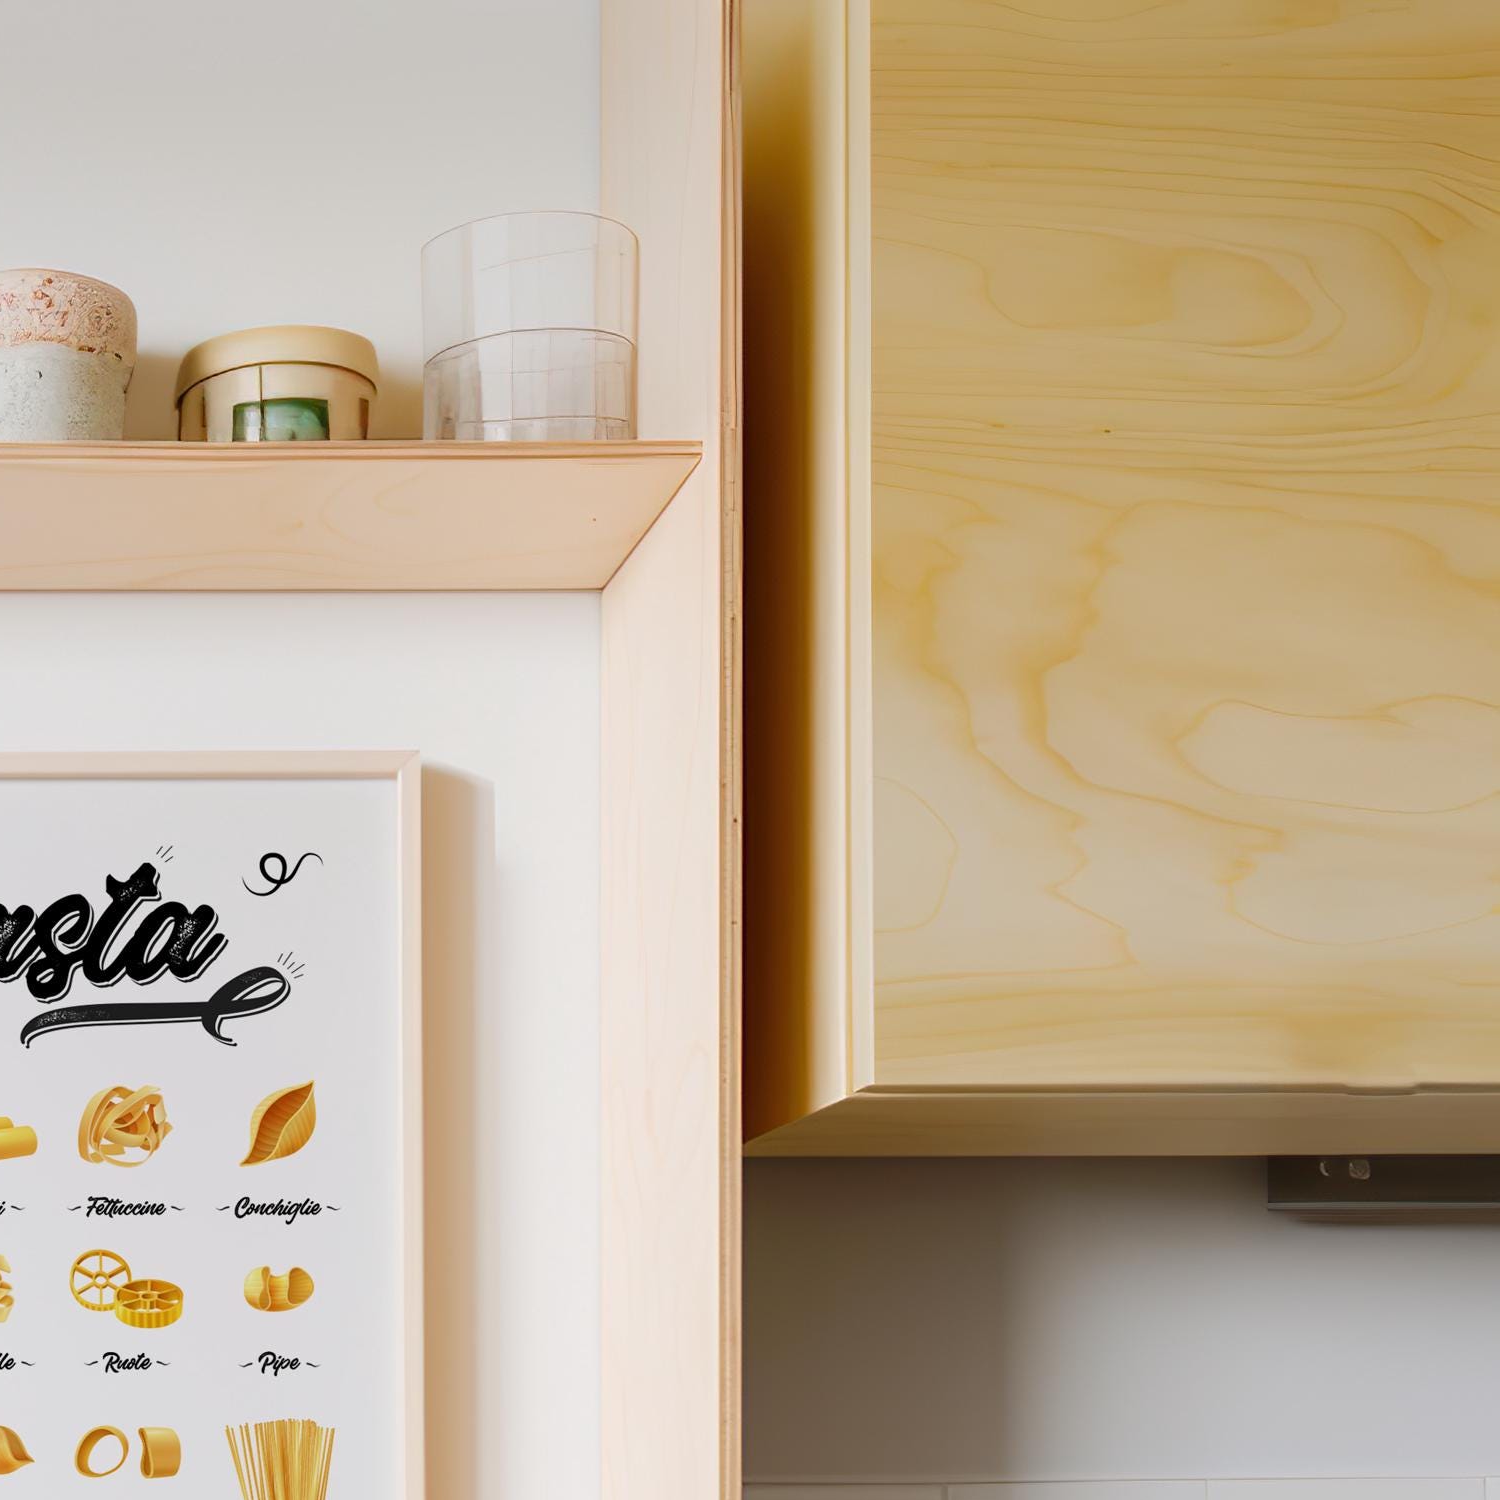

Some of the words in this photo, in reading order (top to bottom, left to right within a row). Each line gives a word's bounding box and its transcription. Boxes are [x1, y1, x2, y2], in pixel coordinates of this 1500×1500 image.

[85, 1195, 167, 1219] Fettuccine
[234, 1196, 323, 1226] Conchiglie
[102, 1351, 153, 1374] Ruote
[257, 1350, 301, 1377] Pipe
